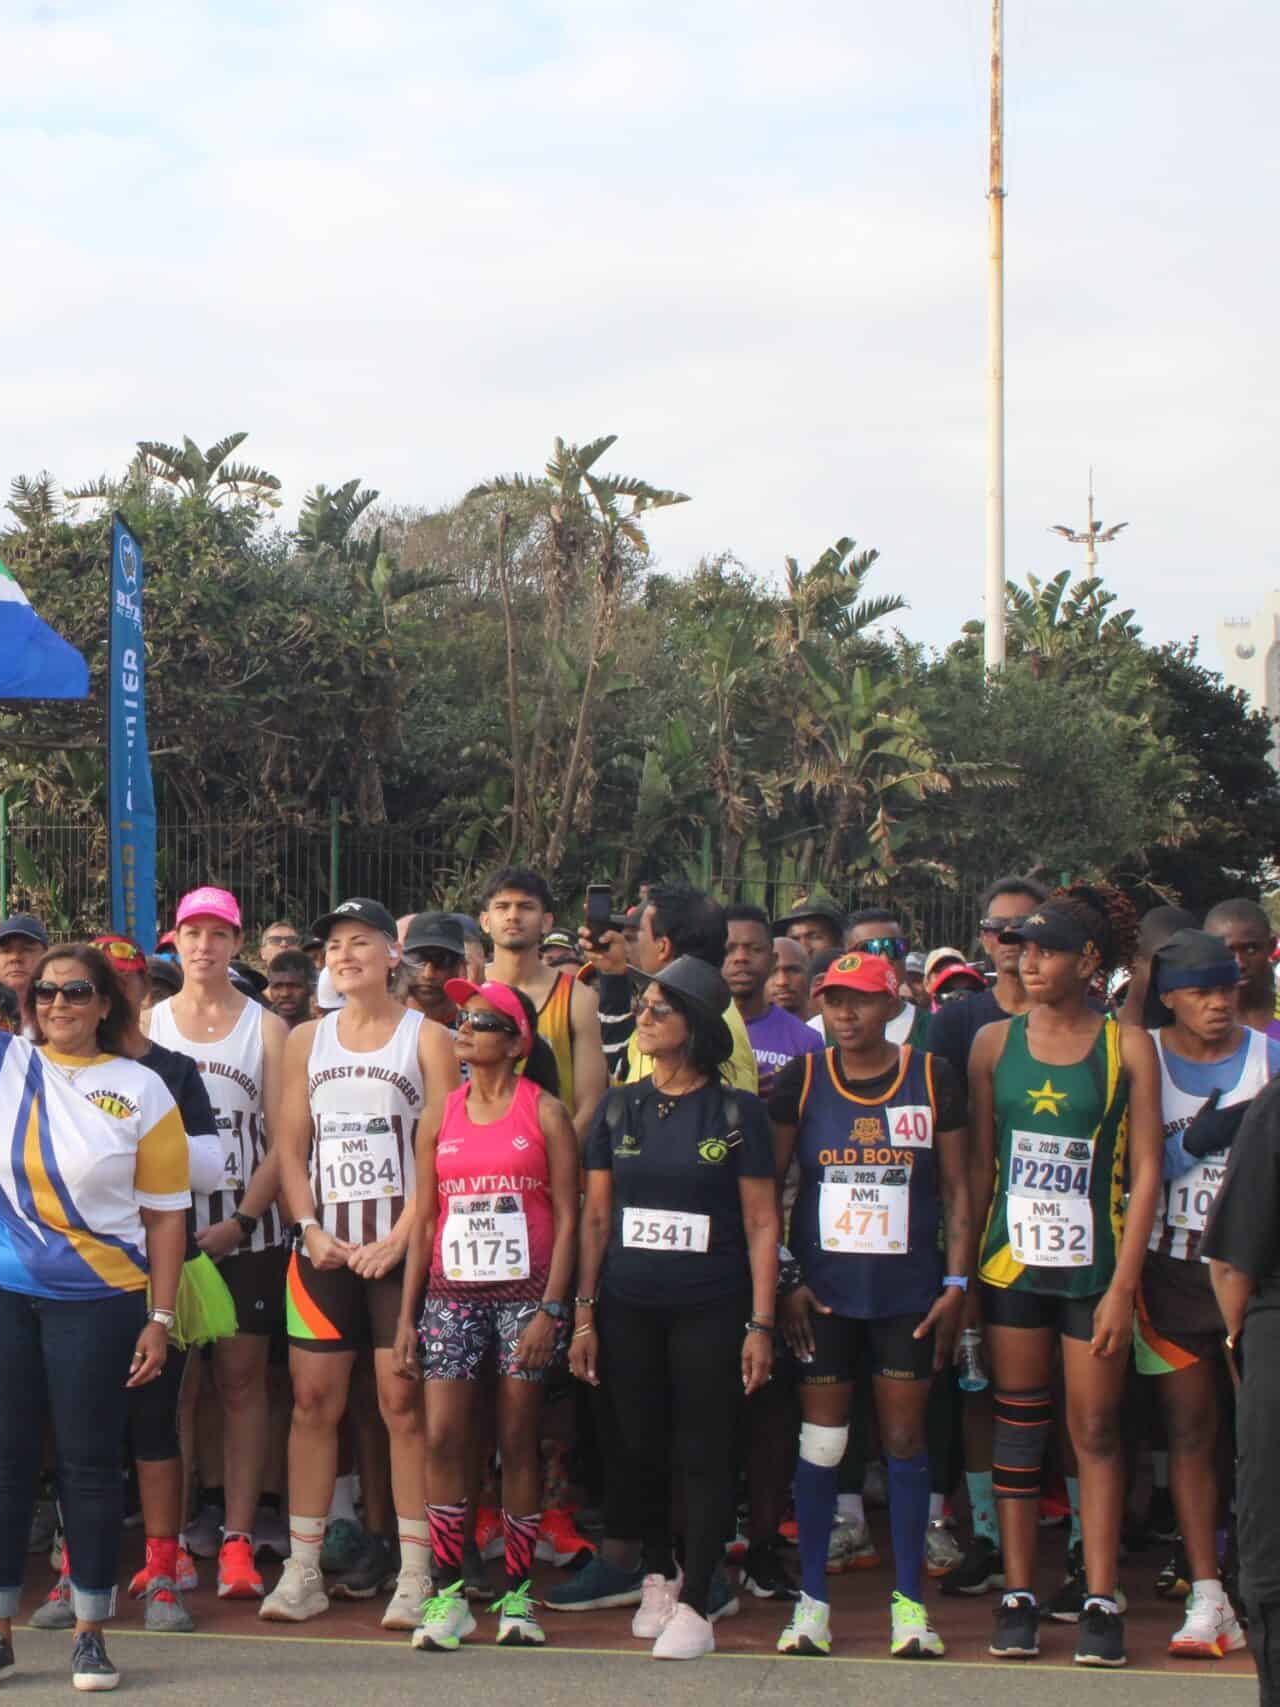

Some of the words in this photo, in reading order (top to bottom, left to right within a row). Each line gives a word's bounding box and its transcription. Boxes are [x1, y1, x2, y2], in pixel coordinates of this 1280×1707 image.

[751, 1048, 793, 1066] WOO
[208, 1061, 258, 1101] VILLAGERS
[367, 1065, 420, 1106] VILLAGERS
[894, 1112, 928, 1142] 40
[818, 1148, 857, 1166] OLD
[863, 1148, 914, 1165] BOYS
[1038, 1141, 1060, 1154] 2025
[325, 1157, 396, 1189] 1084
[854, 1171, 876, 1183] 2025
[1011, 1156, 1088, 1195] P2294
[470, 1201, 491, 1213] 2025
[851, 1187, 879, 1202] NMi
[1032, 1202, 1061, 1217] NMi
[469, 1217, 495, 1231] NMi
[631, 1220, 693, 1247] 2541
[834, 1210, 889, 1237] 471
[1013, 1221, 1086, 1251] 1132
[449, 1239, 522, 1265] 1175
